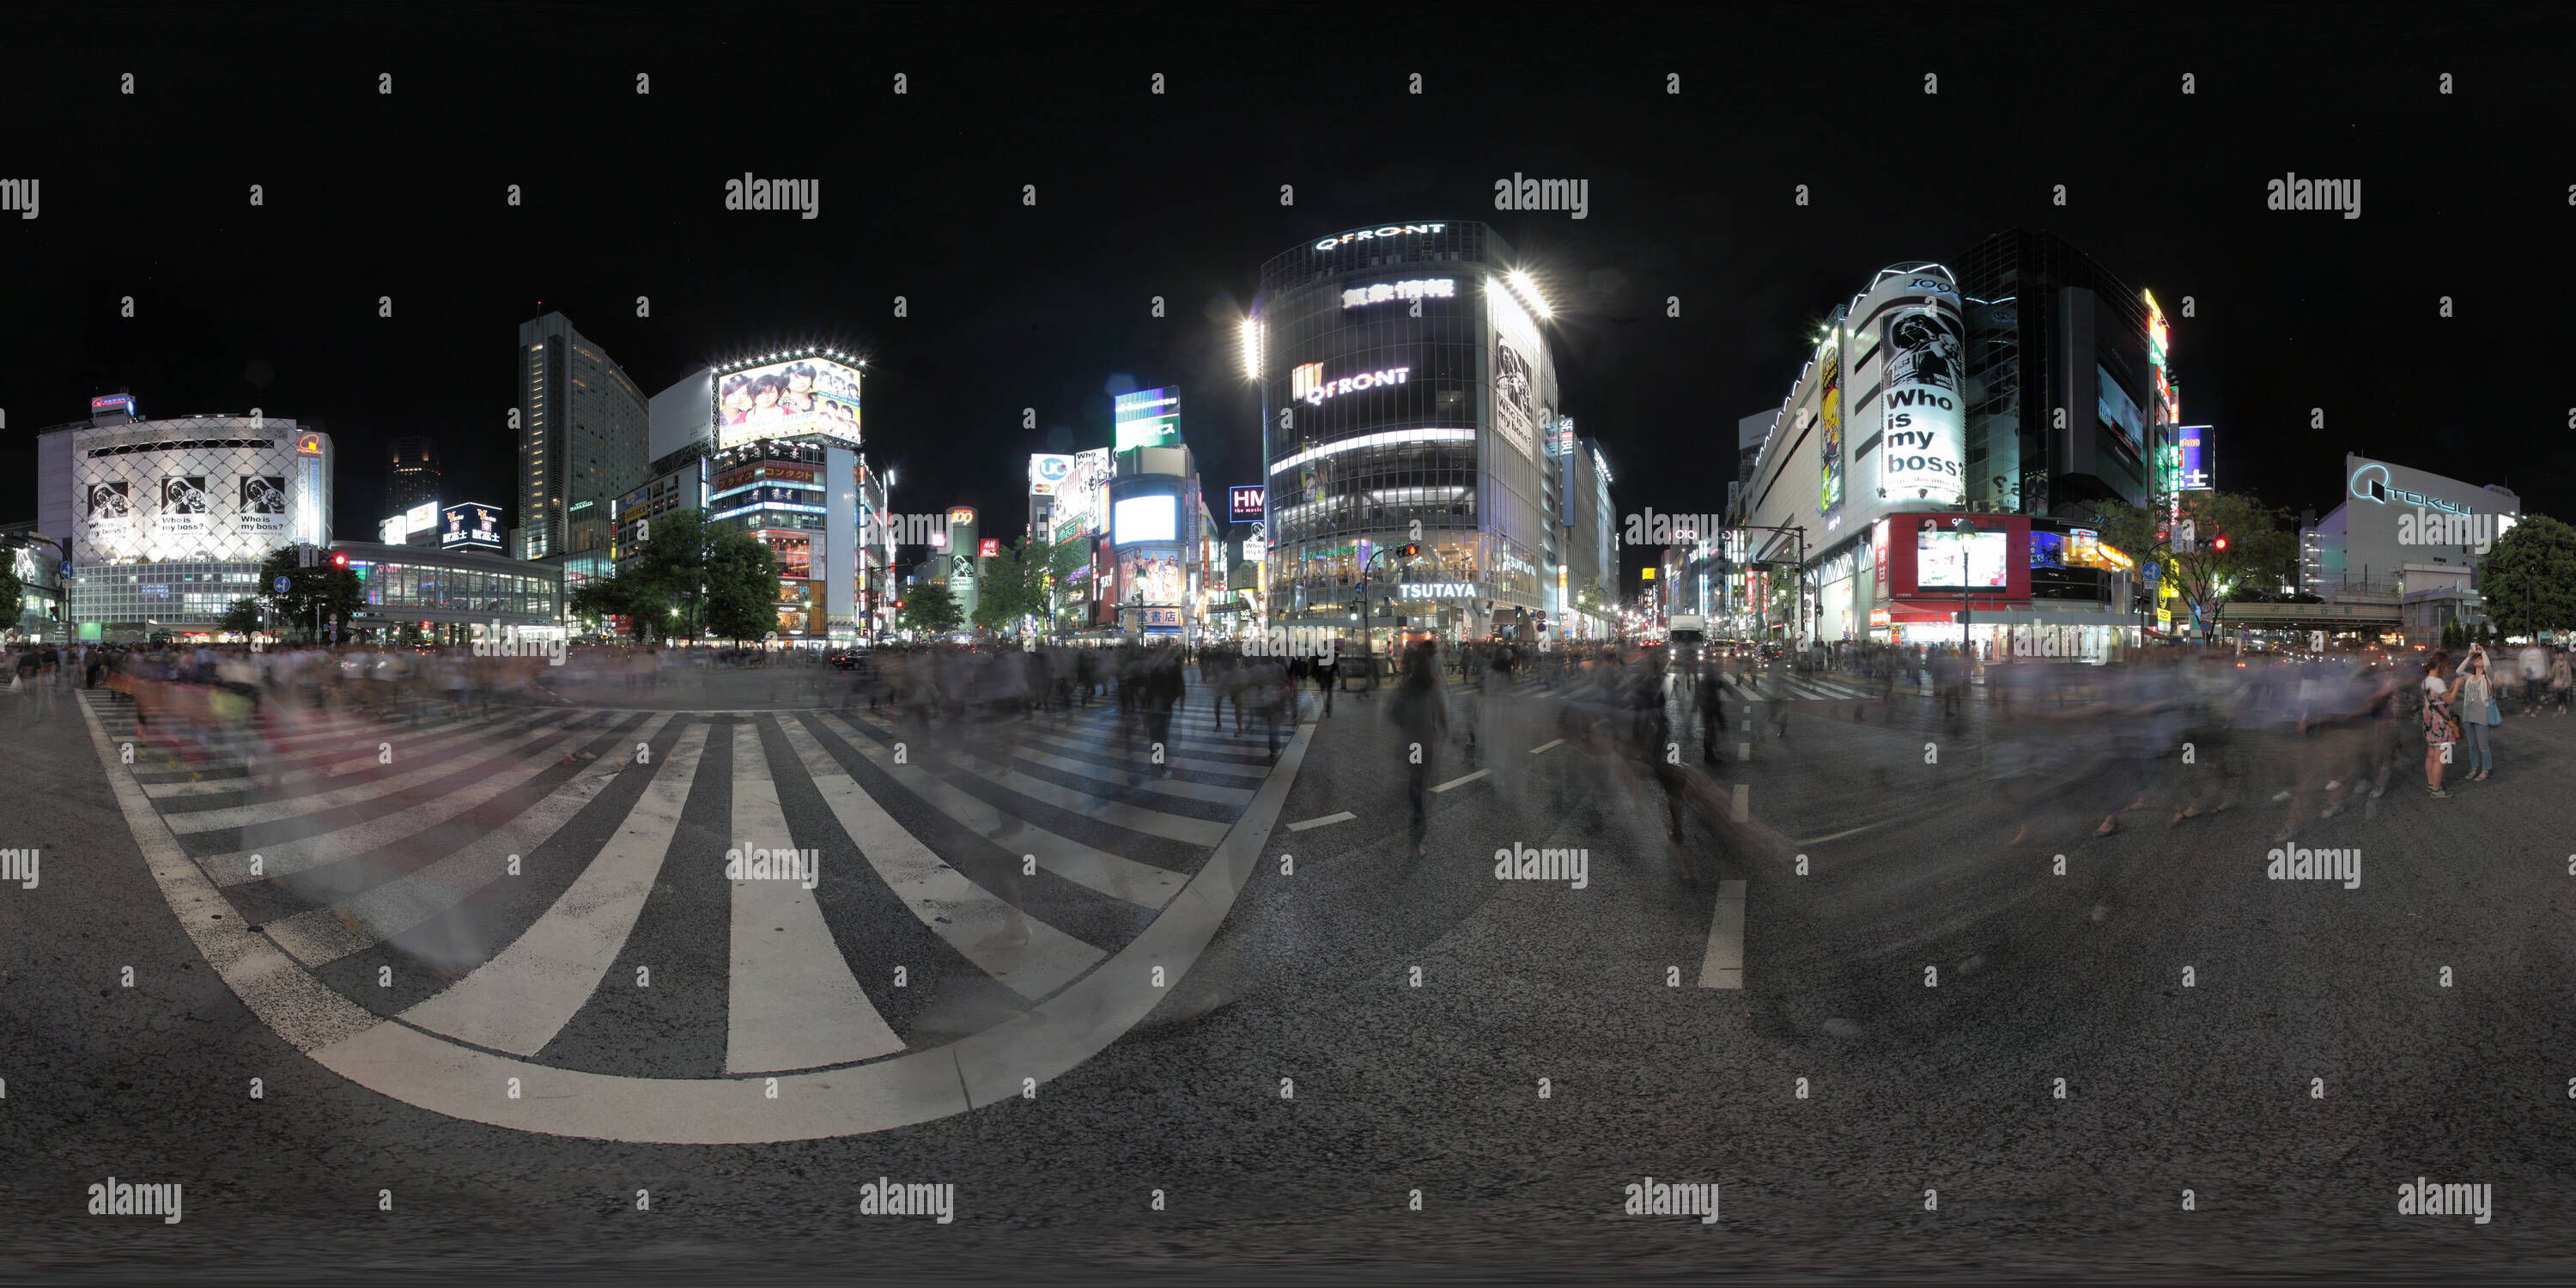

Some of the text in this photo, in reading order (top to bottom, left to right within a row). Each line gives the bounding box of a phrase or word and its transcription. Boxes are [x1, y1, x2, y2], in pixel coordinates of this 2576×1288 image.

[1315, 224, 1445, 250] QFRONT
[1306, 368, 1409, 405] QFRONT
[1886, 388, 1953, 411] Who
[1498, 396, 1522, 427] Who is
[1888, 412, 1911, 430] is
[1498, 411, 1532, 447] my boss?
[1561, 419, 1573, 455] SEIBU
[1888, 431, 1935, 450] my
[766, 467, 812, 480] コンタクト
[1888, 454, 1964, 482] boss?
[1088, 475, 1097, 524] もんじゃ
[2385, 487, 2473, 516] TOKYU
[951, 512, 974, 525] 109
[1400, 583, 1476, 598] TSUTAYA
